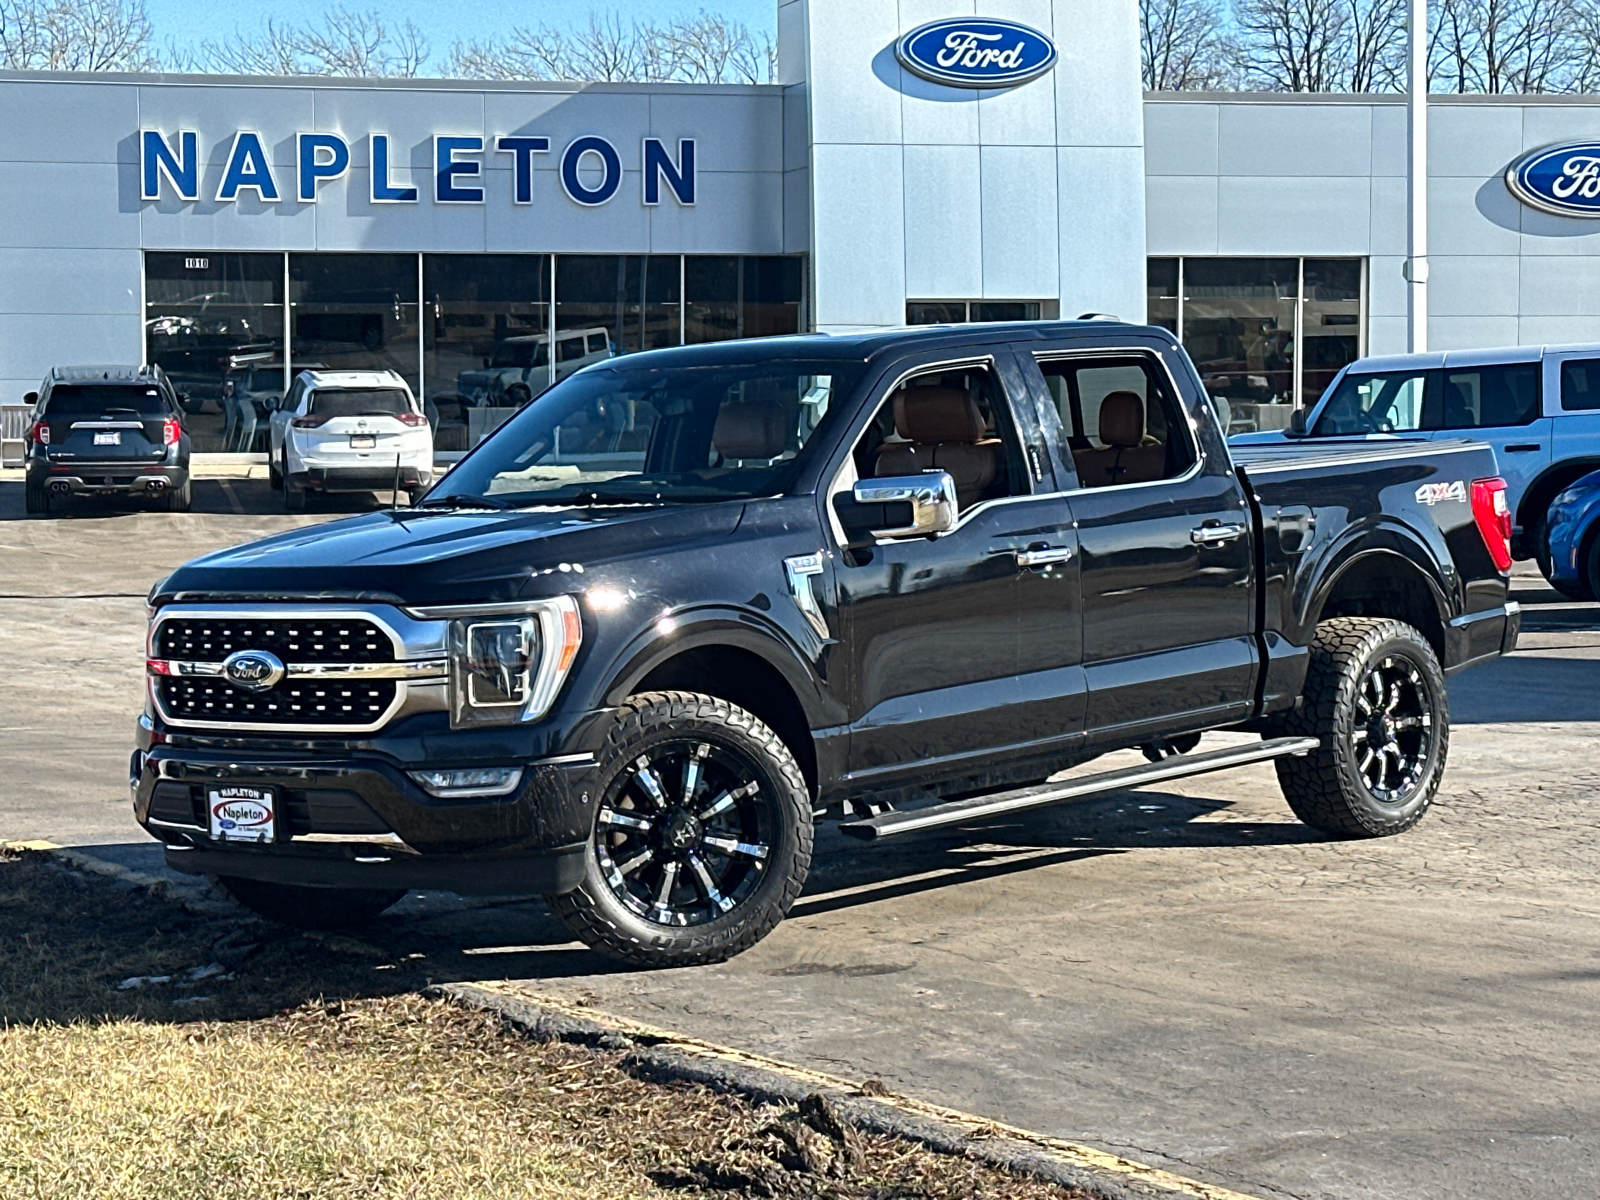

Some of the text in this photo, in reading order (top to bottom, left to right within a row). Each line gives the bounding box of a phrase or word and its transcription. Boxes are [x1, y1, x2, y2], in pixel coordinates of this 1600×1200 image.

[936, 31, 1025, 68] Ford
[139, 128, 698, 207] NAPLETON
[1552, 156, 1600, 198] Fo
[186, 258, 208, 268] 1010
[233, 660, 262, 679] Ford
[221, 788, 259, 798] NAPLETON
[223, 806, 263, 821] Napleton
